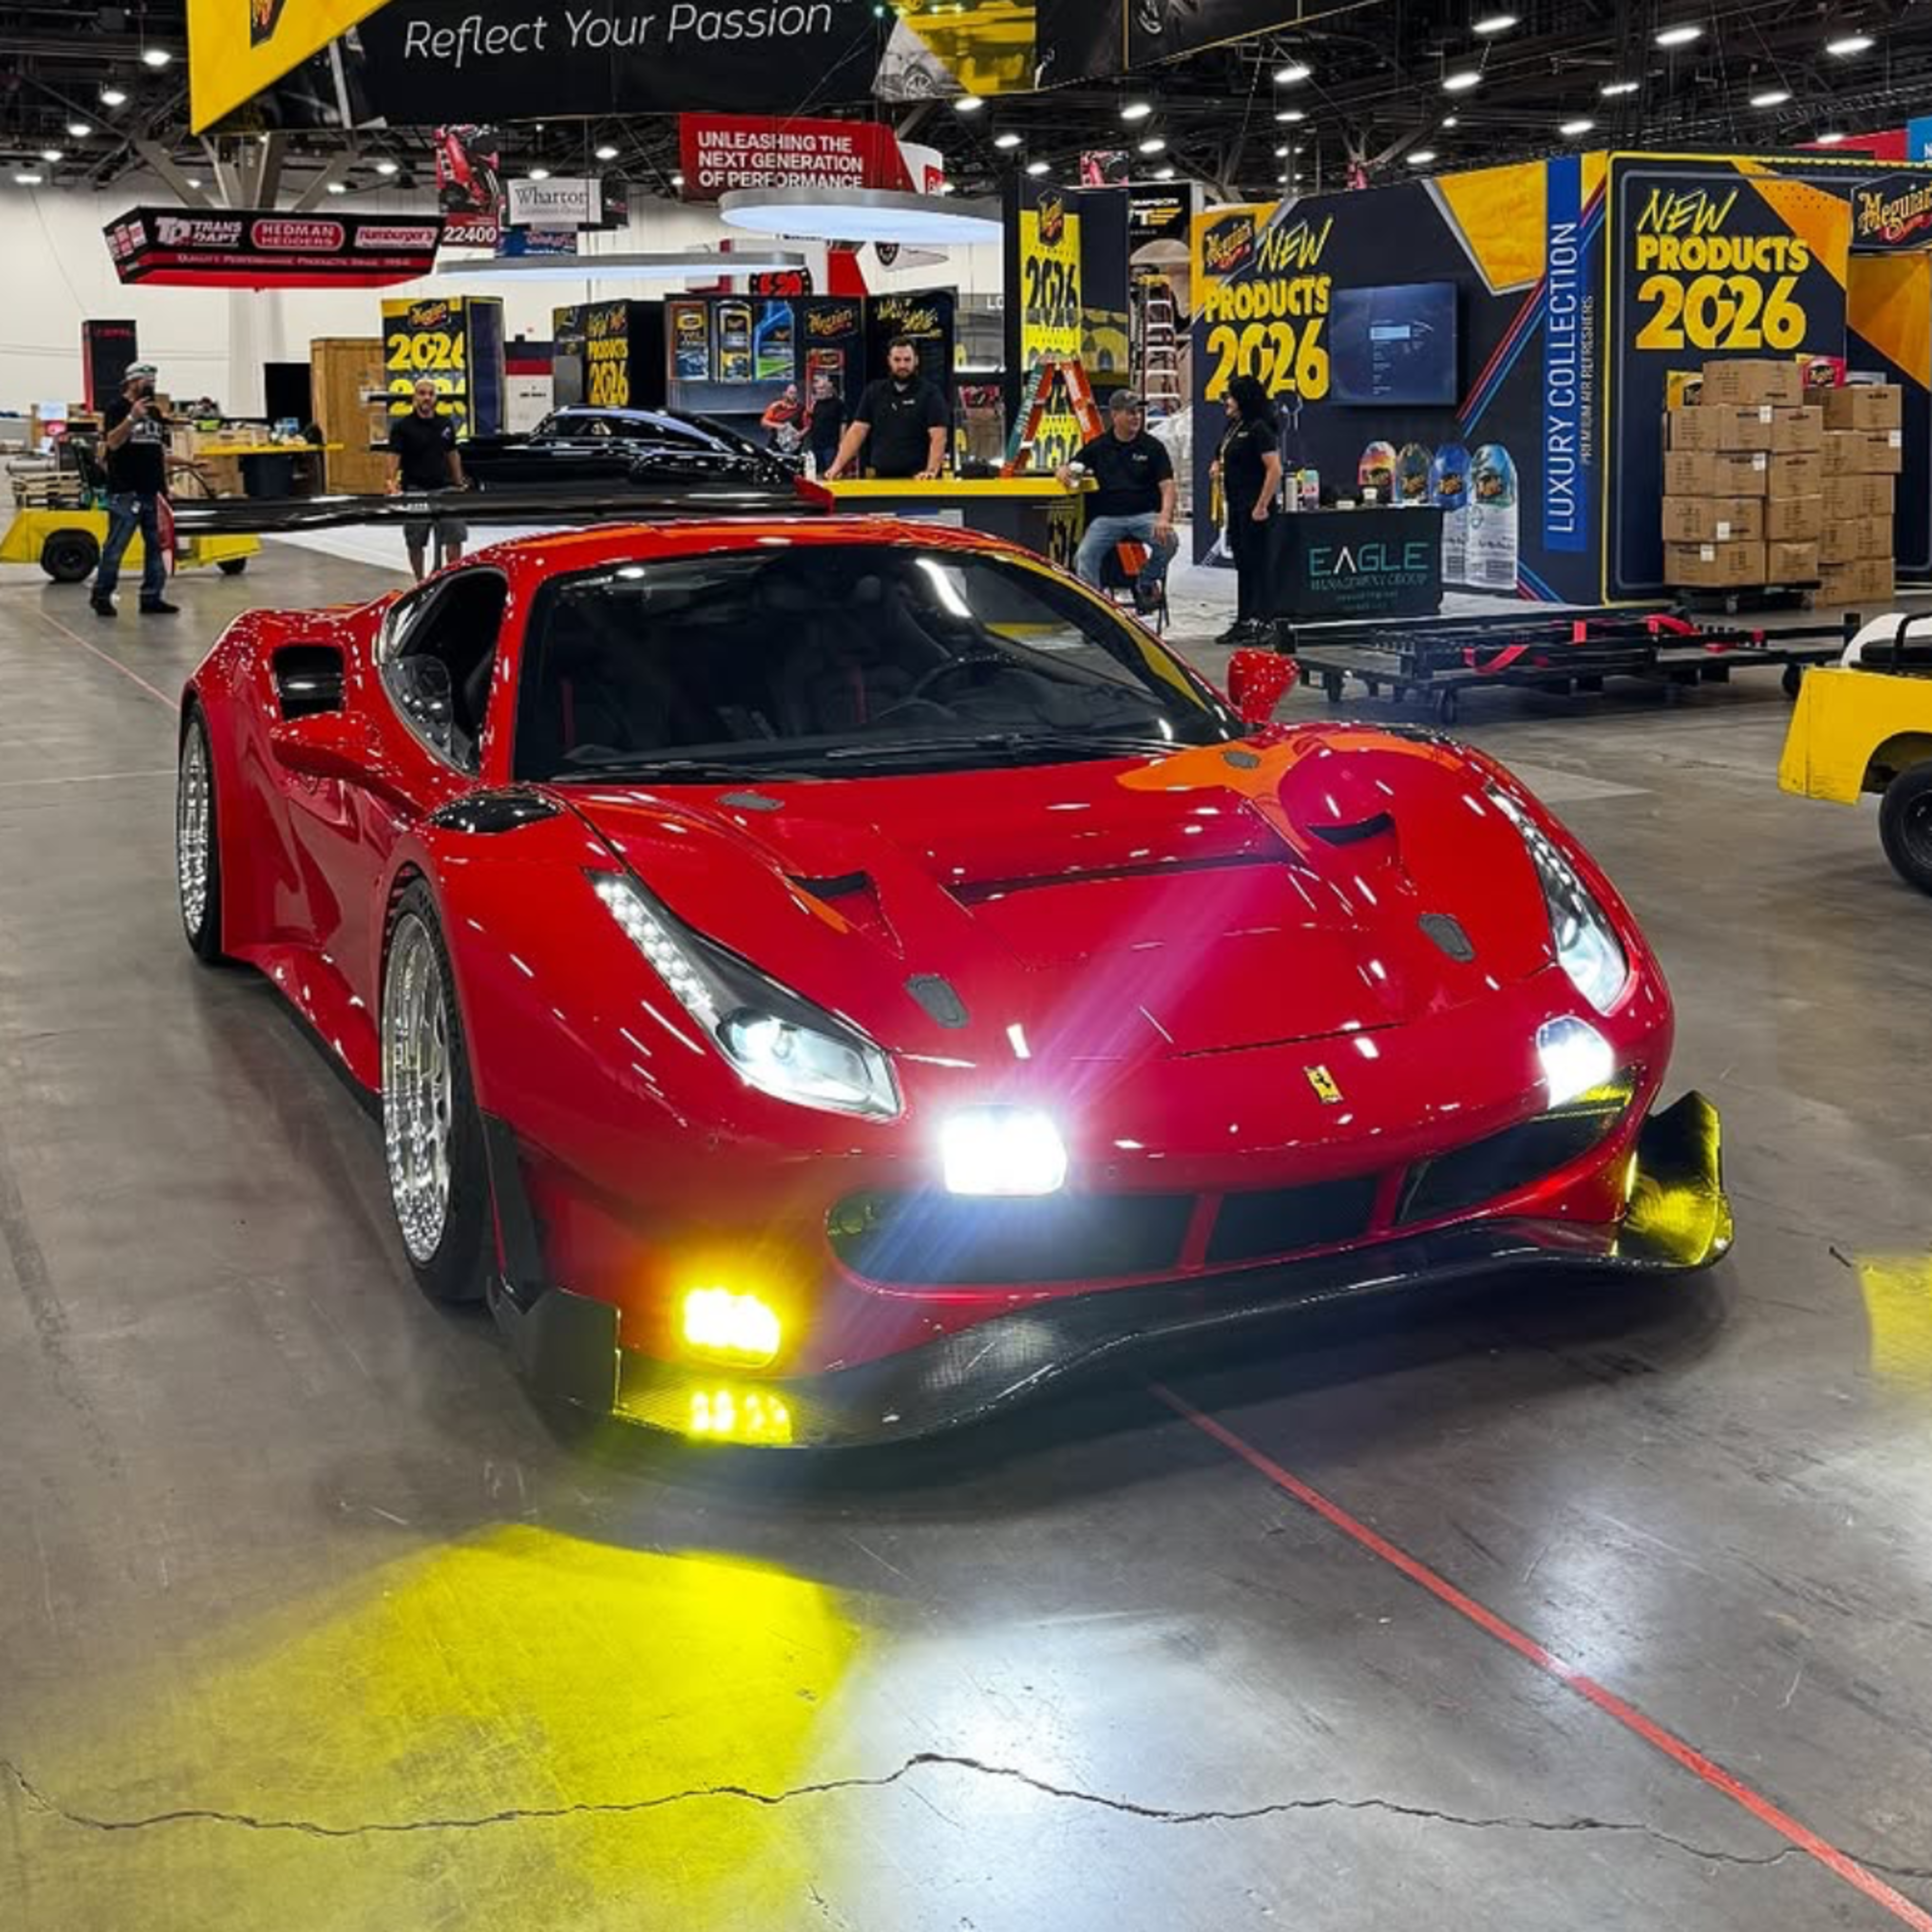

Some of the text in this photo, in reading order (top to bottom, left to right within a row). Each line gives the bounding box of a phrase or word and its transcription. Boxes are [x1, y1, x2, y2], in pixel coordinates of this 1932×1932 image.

[404, 0, 832, 68] Reflect Your Passion
[697, 131, 853, 153] UNLEASHING THE
[698, 151, 863, 172] NEXT GENERATION
[699, 171, 863, 189] OF PERFORMANCE
[444, 227, 497, 242] 22400
[1637, 187, 1739, 235] NEW
[1257, 217, 1334, 272] NEW
[1636, 235, 1810, 272] PRODUCTS
[1204, 274, 1332, 322] PRODUCTS
[1636, 274, 1807, 349] 2026
[1204, 317, 1330, 401] 2026
[1547, 222, 1577, 533] LUXURY COLLECTION
[589, 360, 628, 406] 2026
[1309, 541, 1429, 576] EAGLE
